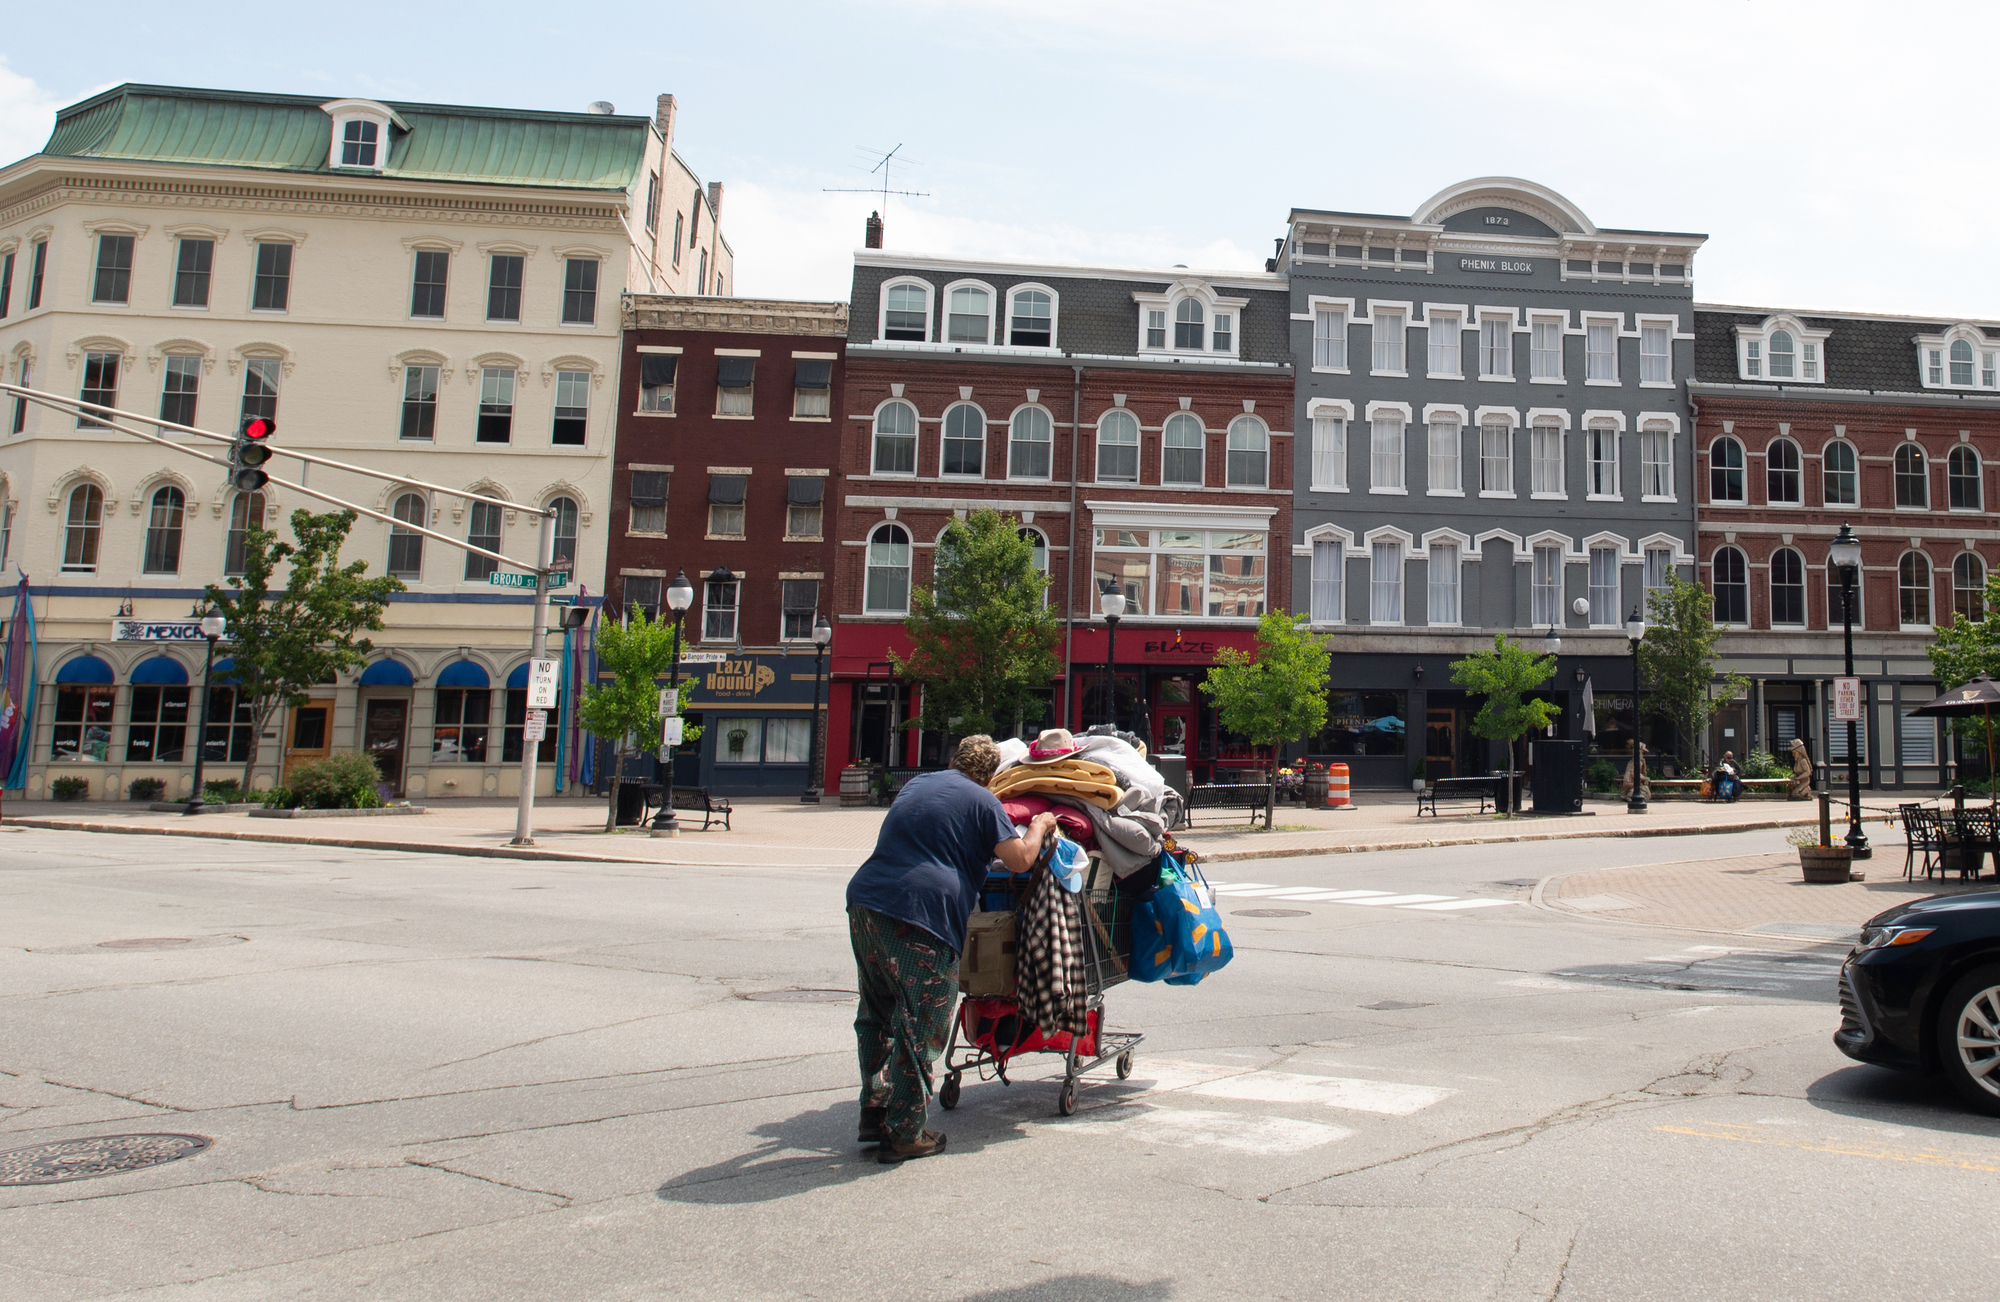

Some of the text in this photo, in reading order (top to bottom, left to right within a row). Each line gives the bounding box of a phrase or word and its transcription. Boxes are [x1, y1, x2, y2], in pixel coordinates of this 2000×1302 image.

[1486, 217, 1509, 225] 1873
[1461, 259, 1533, 272] PHENIX BLOCK
[493, 573, 535, 587] BROAD ST
[146, 625, 206, 639] MEXICA
[1144, 641, 1214, 654] BLAZE
[687, 653, 705, 661] Bangor
[705, 653, 719, 661] Pride
[538, 662, 551, 673] NO
[716, 660, 753, 676] Lazy
[536, 676, 552, 684] TURN
[706, 673, 754, 690] Hound
[538, 686, 548, 694] ON
[1842, 682, 1851, 690] NO
[536, 696, 548, 704] RED
[1593, 699, 1635, 710] CHIMERA
